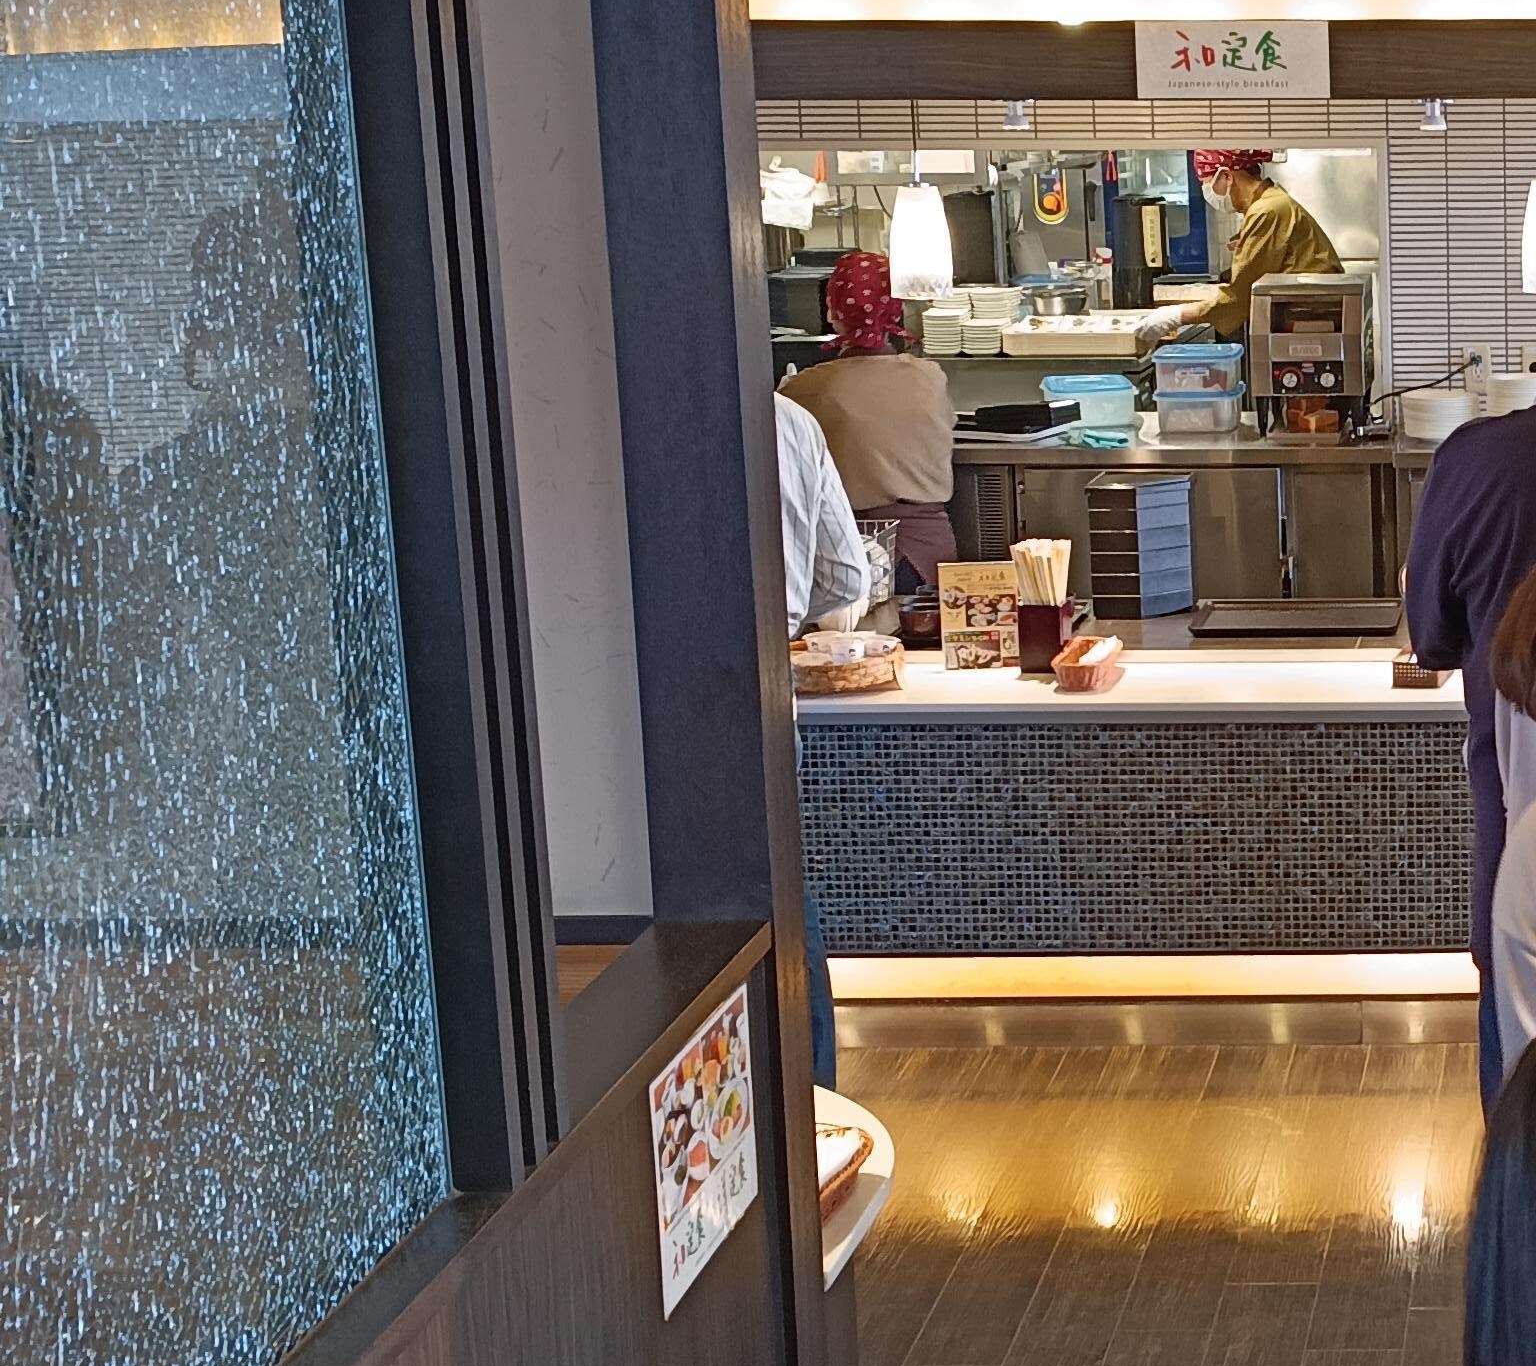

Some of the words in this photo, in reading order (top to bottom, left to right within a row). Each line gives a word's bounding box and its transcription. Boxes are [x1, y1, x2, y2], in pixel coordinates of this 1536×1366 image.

[1171, 30, 1287, 72] 和定食
[1168, 79, 1239, 89] Japanese-style
[1243, 79, 1289, 88] breakfast
